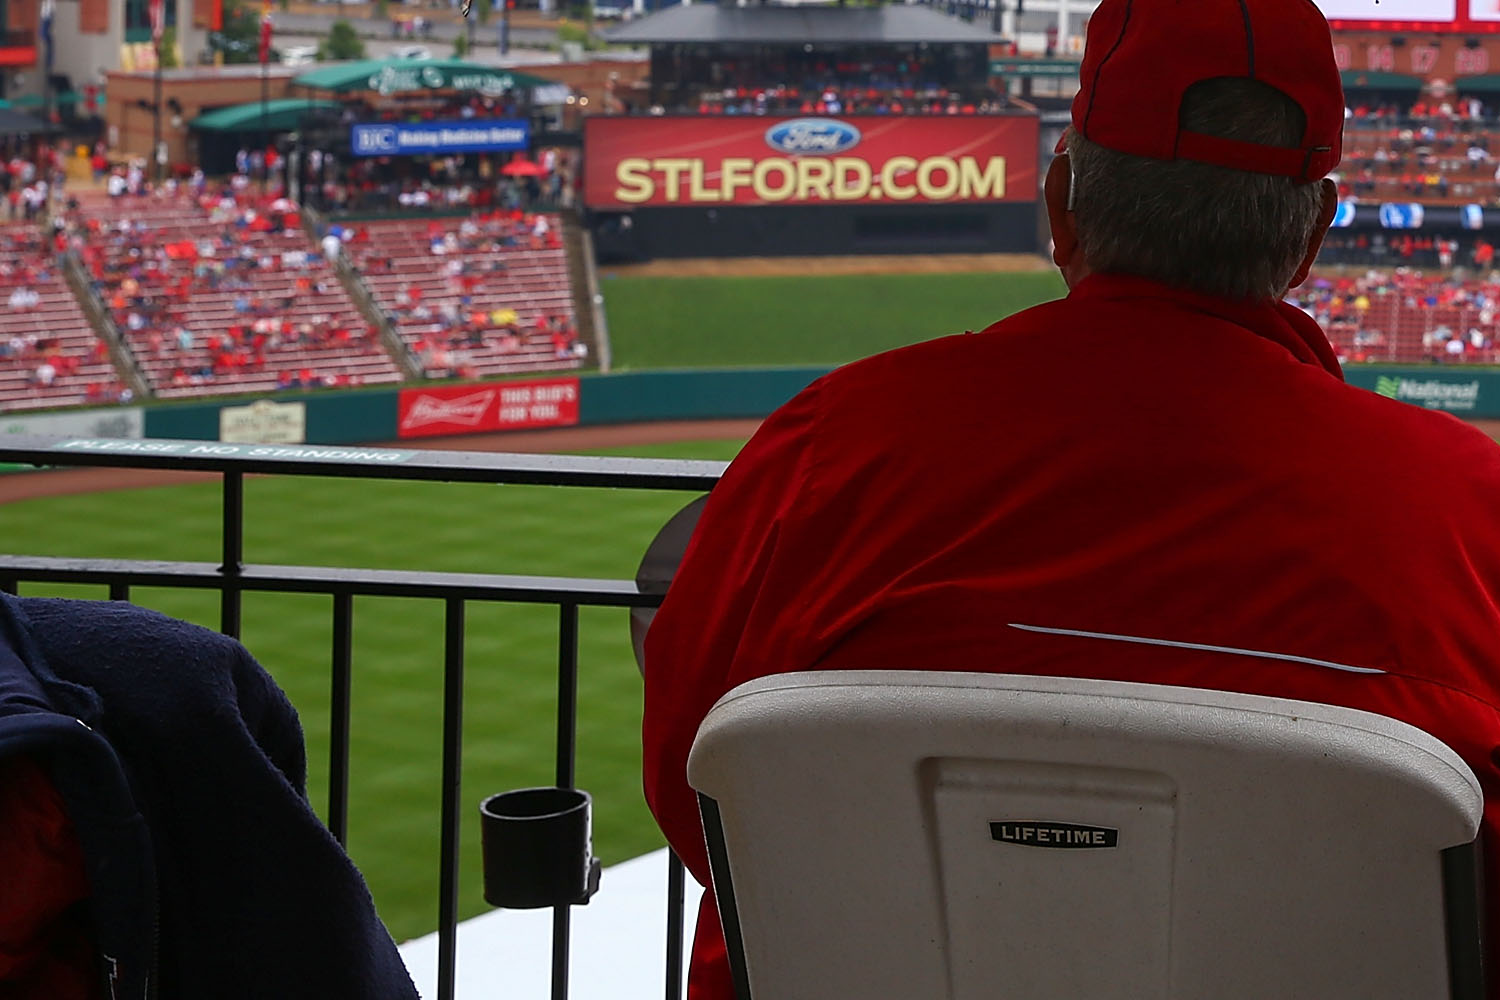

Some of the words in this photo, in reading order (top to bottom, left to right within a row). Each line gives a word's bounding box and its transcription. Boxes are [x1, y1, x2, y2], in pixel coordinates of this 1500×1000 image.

[781, 124, 842, 151] Ford
[615, 156, 1007, 202] STLFORD.COM
[1398, 378, 1480, 401] National
[64, 439, 181, 455] PLEASE
[189, 445, 239, 456] NO
[247, 447, 401, 463] STANDING
[1001, 825, 1106, 844] LIFETIME
